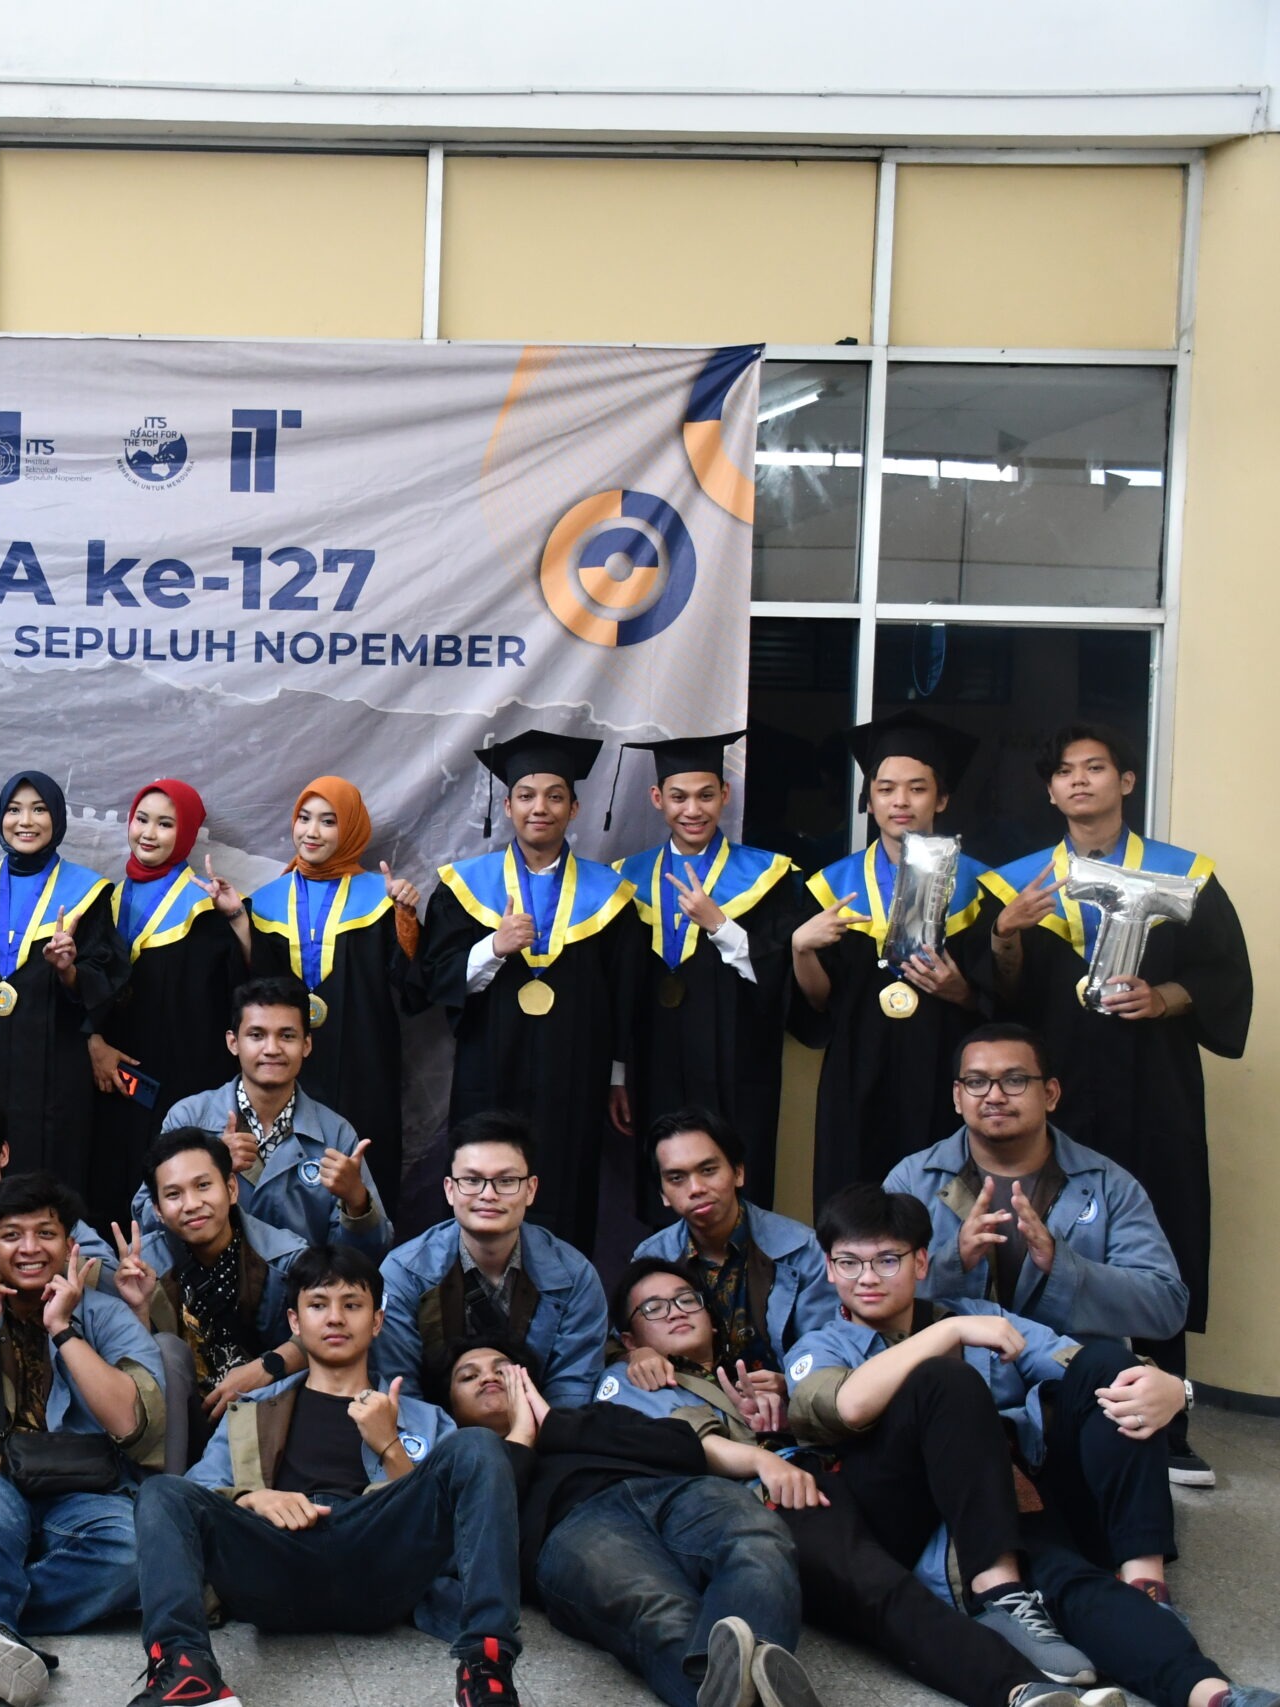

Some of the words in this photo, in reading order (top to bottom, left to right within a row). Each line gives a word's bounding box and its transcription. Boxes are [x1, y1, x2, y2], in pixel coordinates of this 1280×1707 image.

[160, 430, 178, 439] FOR
[123, 438, 140, 447] THE
[142, 438, 159, 447] TOP
[141, 483, 165, 492] UNTUK
[85, 539, 377, 612] ke-127
[14, 625, 235, 663] SEPULUH
[254, 631, 527, 668] NOPEMBER
